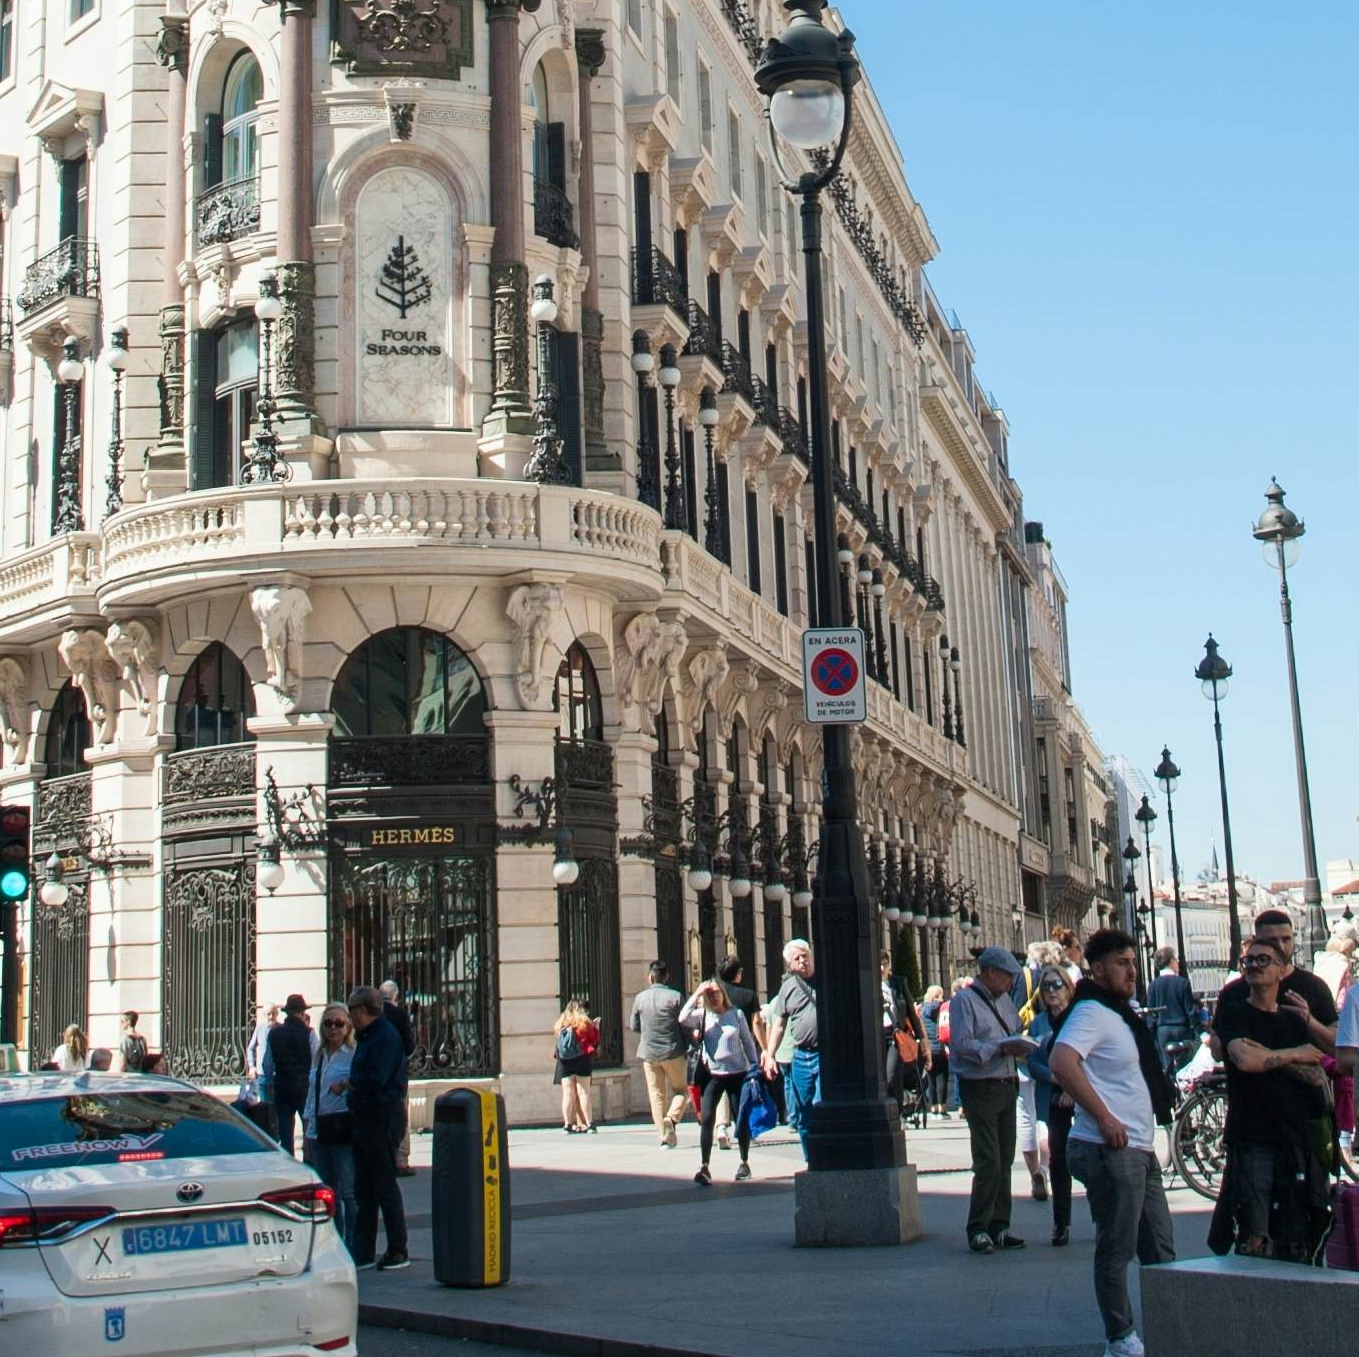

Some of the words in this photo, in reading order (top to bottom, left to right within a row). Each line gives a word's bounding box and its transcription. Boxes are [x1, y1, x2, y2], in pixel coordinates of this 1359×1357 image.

[808, 637, 821, 645] EN
[825, 636, 857, 645] ACERA
[829, 708, 855, 716] MOTOR
[371, 827, 455, 845] HERMÈS
[13, 1140, 130, 1161] FREENOW
[93, 1236, 113, 1266] X
[139, 1228, 197, 1251] 6847
[201, 1221, 243, 1244] LMT
[252, 1230, 293, 1245] 05152
